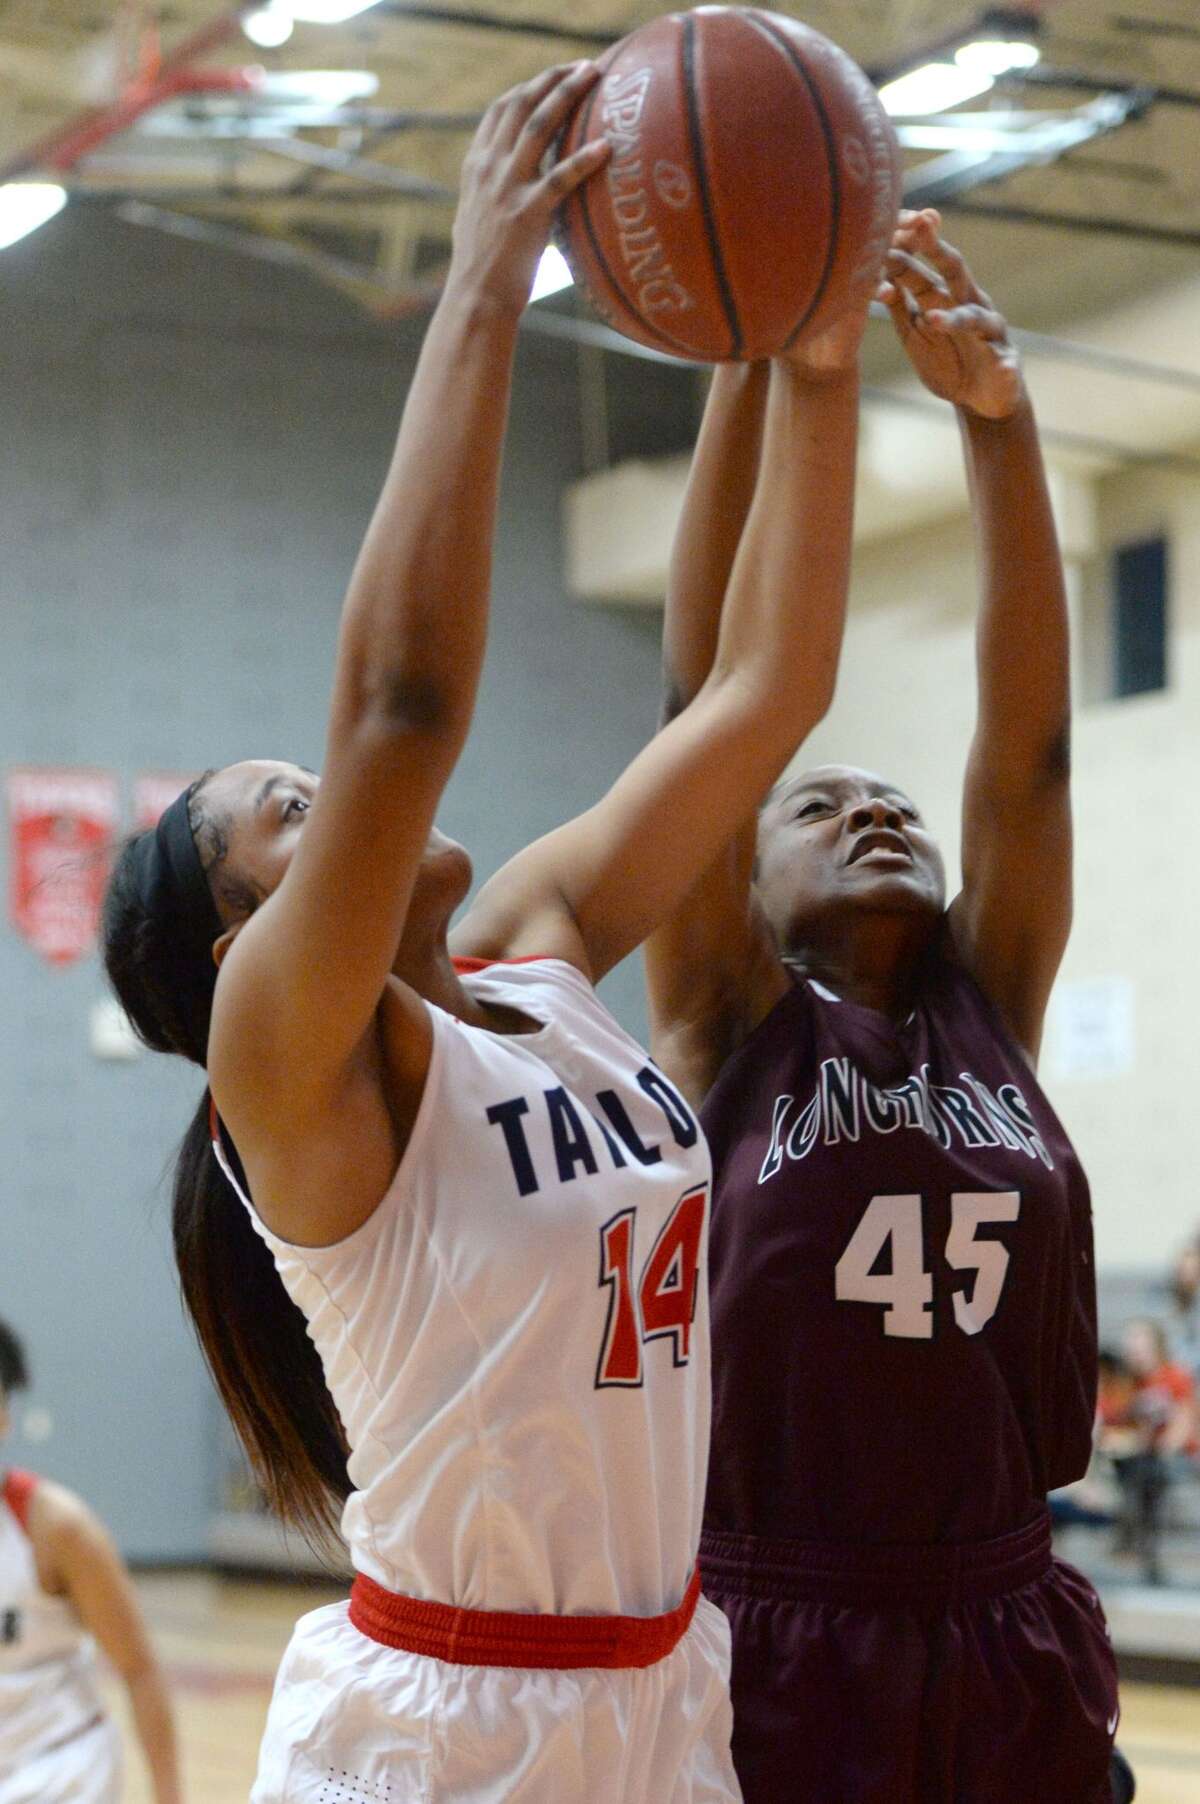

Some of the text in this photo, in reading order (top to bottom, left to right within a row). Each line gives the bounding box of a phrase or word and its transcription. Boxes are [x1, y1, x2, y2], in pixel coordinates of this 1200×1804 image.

[601, 65, 692, 315] SPALDING
[485, 1057, 698, 1198] TALO
[594, 1180, 709, 1390] 14
[834, 1190, 1021, 1339] 45
